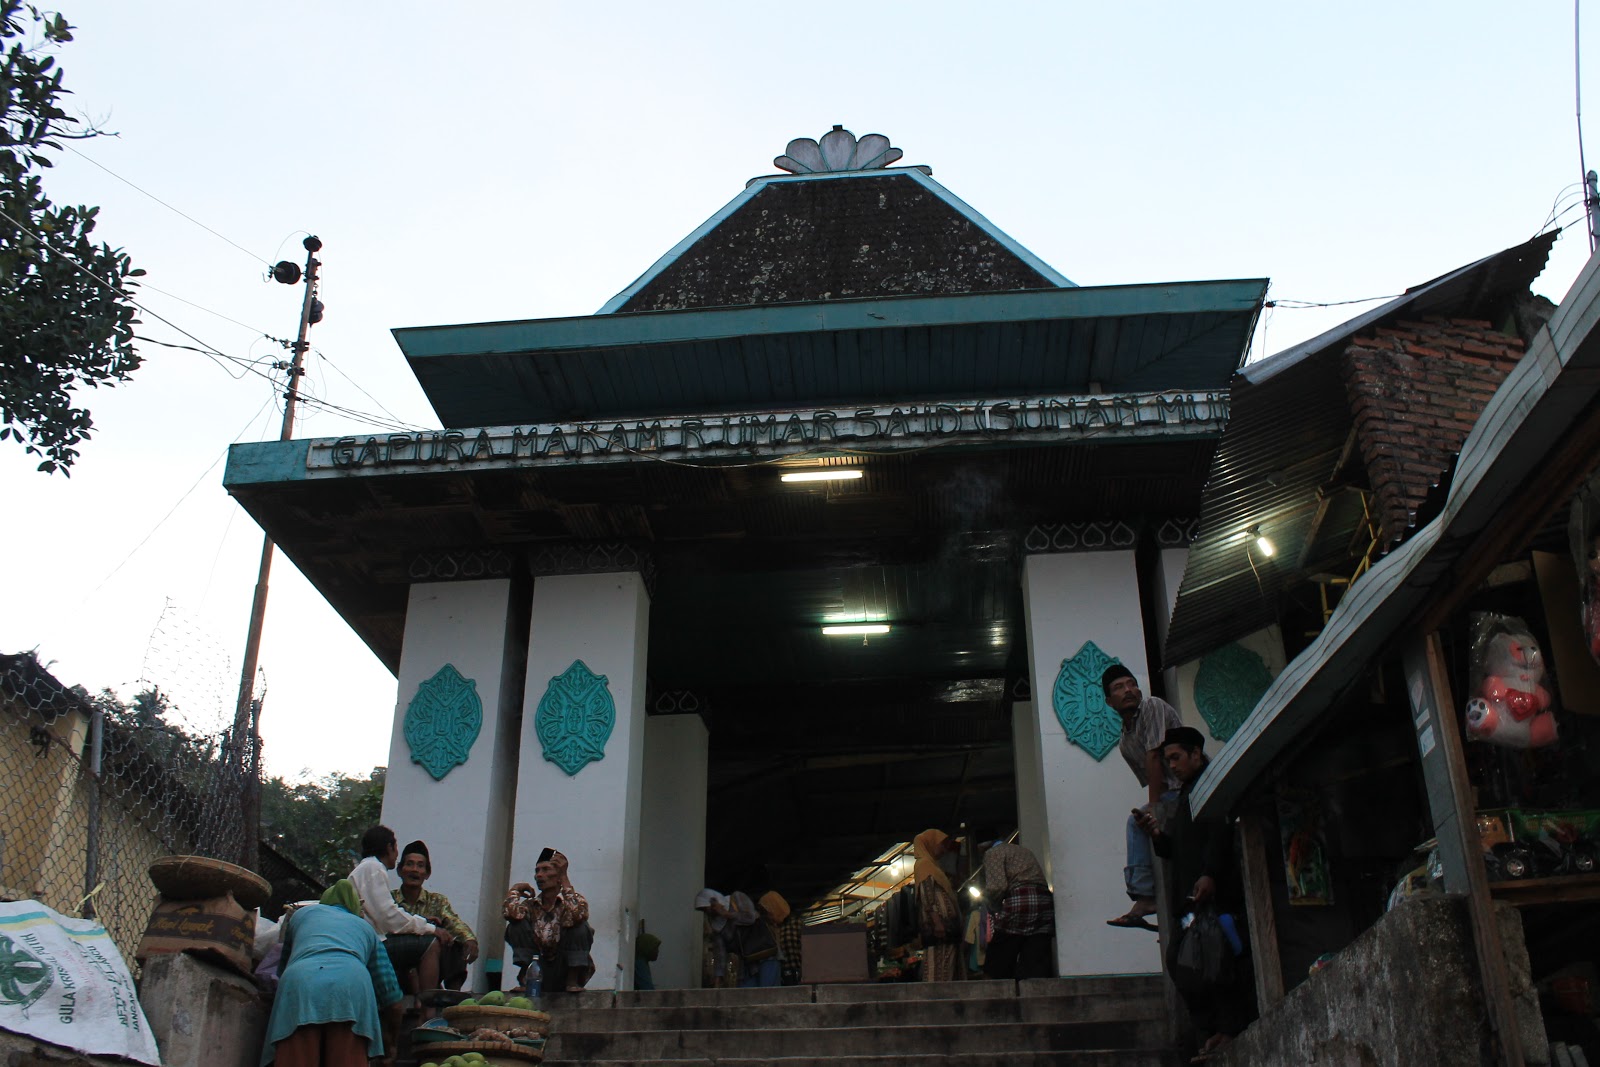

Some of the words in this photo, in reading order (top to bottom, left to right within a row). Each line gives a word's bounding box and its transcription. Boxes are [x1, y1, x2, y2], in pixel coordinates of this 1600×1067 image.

[332, 428, 494, 470] GAPURA
[511, 420, 662, 461] MAKAM
[723, 411, 837, 448] UMAR
[19, 932, 50, 956] PUTIH
[58, 992, 76, 1024] GULA
[127, 991, 140, 1033] JANGAN
